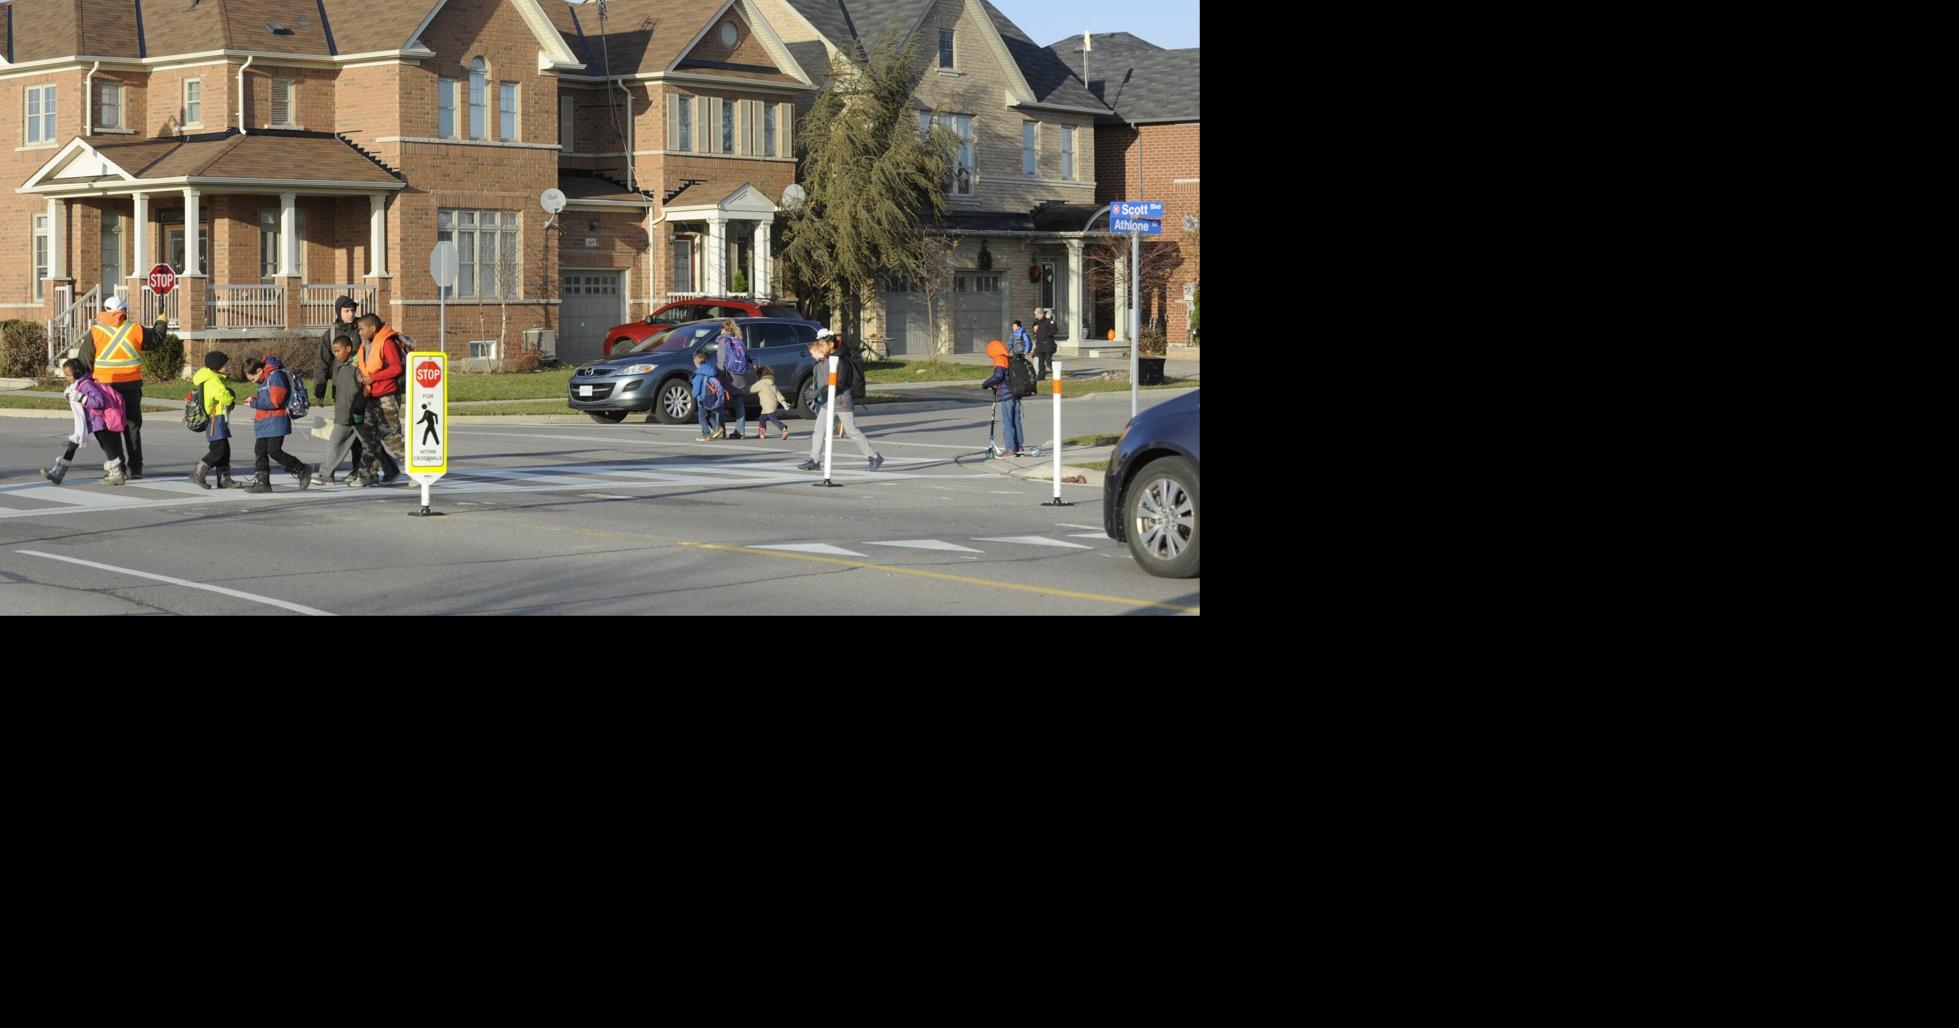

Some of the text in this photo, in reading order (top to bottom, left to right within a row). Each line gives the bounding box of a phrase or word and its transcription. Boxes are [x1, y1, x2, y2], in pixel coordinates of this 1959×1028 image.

[1121, 203, 1148, 215] Scott
[1114, 219, 1149, 231] Athlone
[150, 273, 173, 288] STOP
[417, 368, 440, 380] STOP
